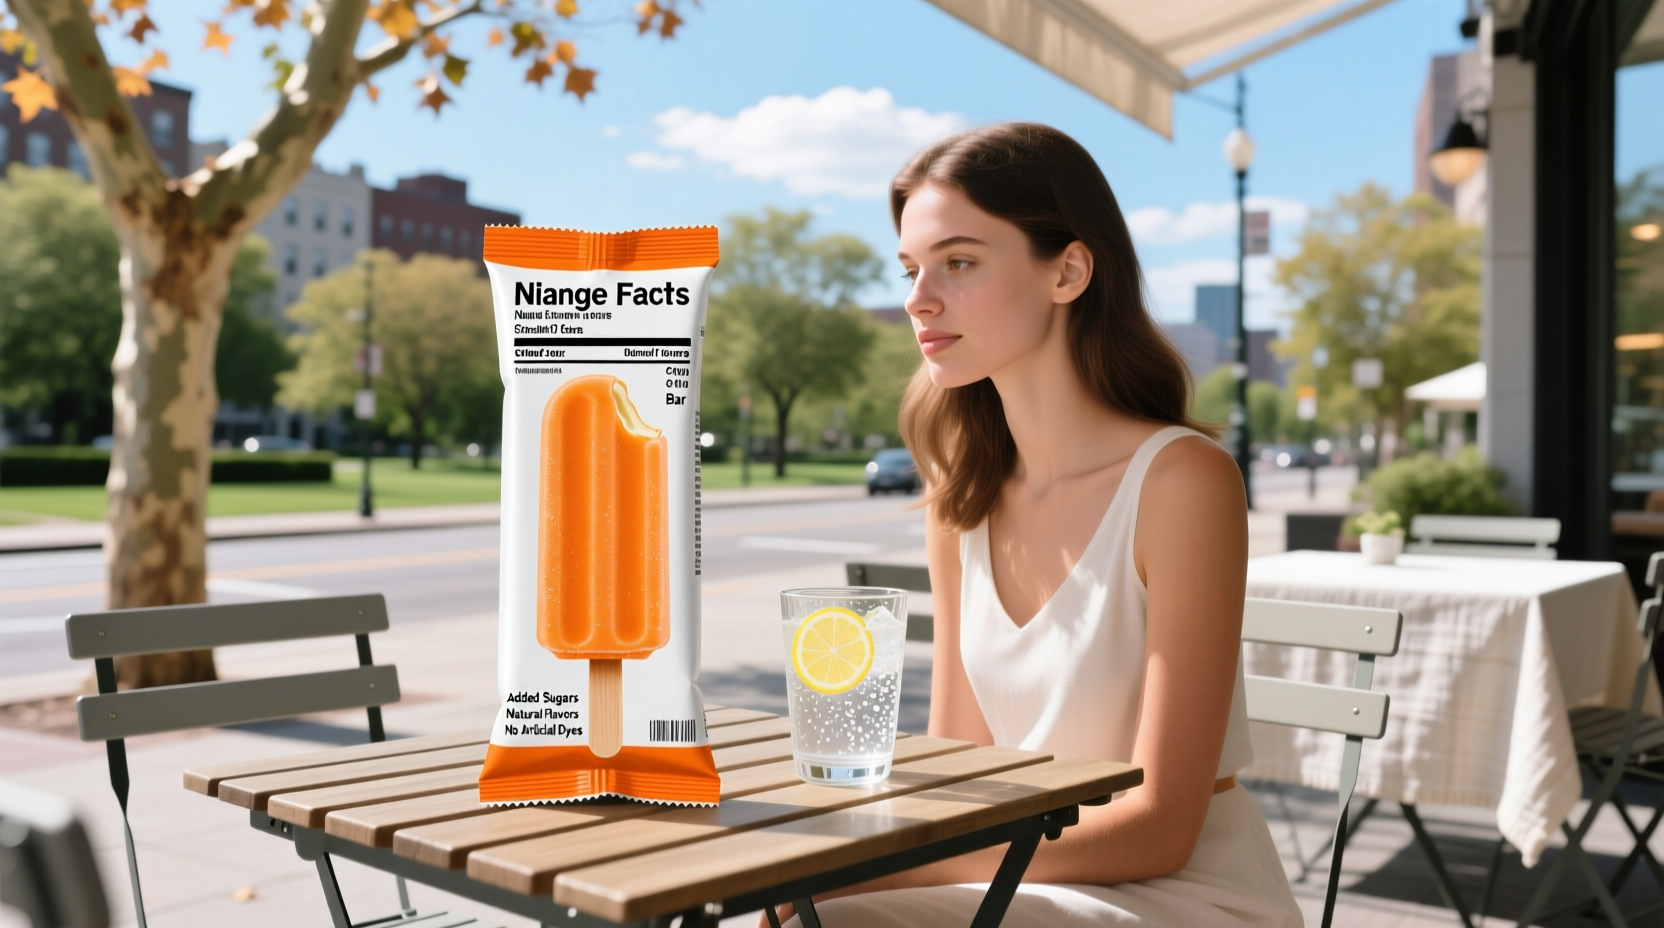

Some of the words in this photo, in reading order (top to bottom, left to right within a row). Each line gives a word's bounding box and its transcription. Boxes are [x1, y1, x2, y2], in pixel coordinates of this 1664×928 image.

[514, 281, 608, 312] Niange
[616, 281, 690, 306] Facts
[665, 392, 687, 406] Bar
[506, 691, 540, 703] Added
[542, 691, 580, 706] Sugars
[506, 708, 543, 719] Natural
[505, 724, 519, 736] No
[558, 723, 583, 739] Dyes
